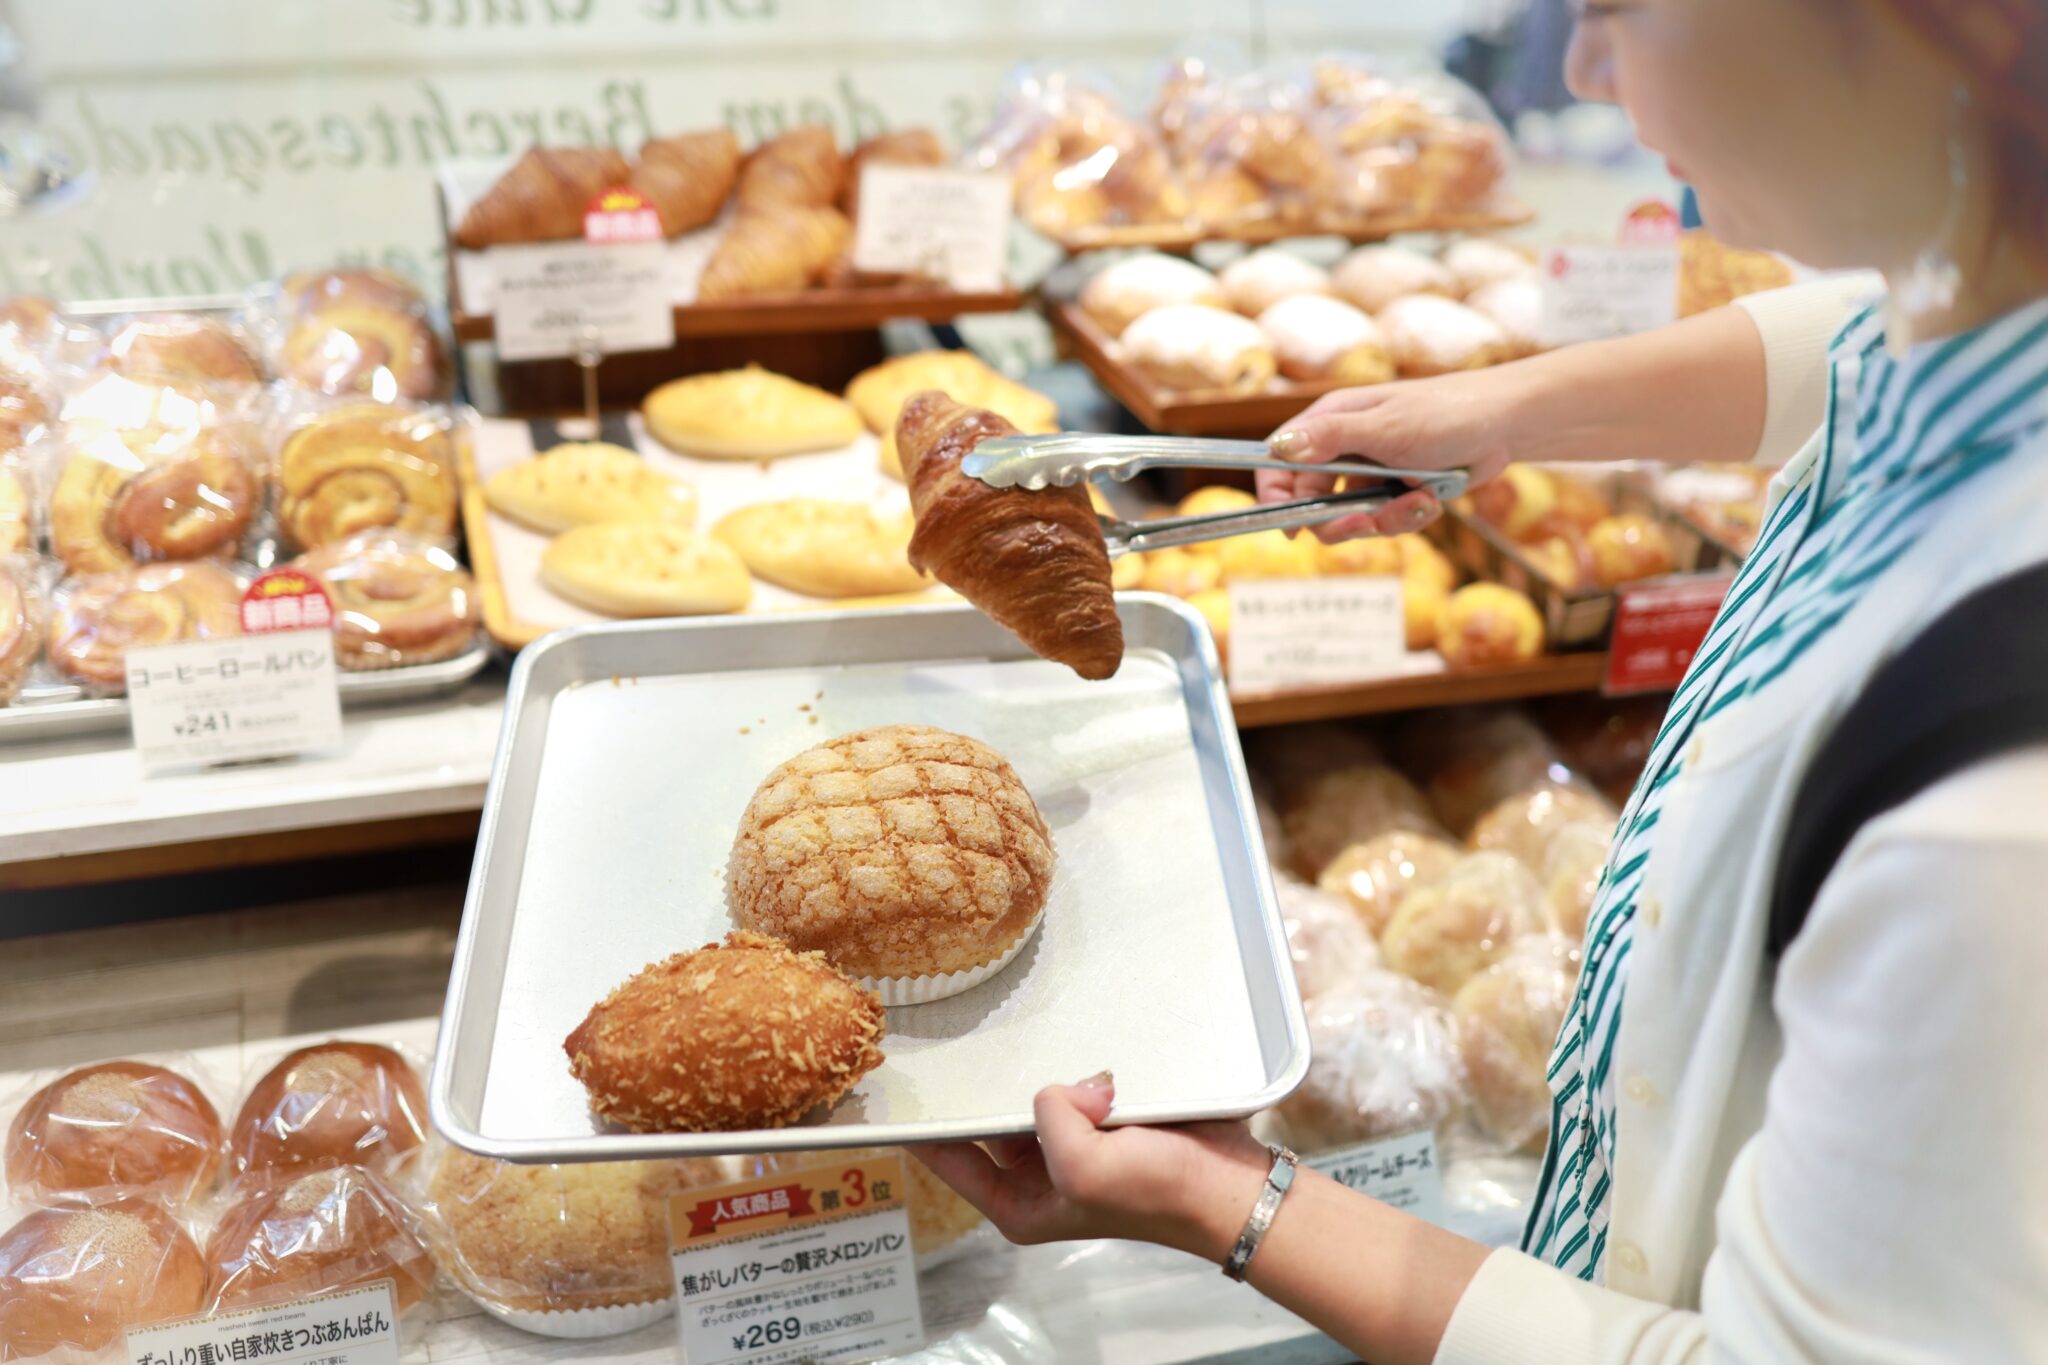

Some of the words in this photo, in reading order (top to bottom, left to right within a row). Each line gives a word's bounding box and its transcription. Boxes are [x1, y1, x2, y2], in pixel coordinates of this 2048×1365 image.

[131, 649, 326, 689] コーヒーロールパン
[711, 1189, 791, 1222] 人気商品
[820, 1168, 892, 1211] 第3位
[681, 1231, 905, 1297] 焦がしバターの贅沢メロンパン
[218, 1322, 246, 1332] mashed
[248, 1318, 268, 1327] sweet
[270, 1315, 283, 1323] red
[284, 1311, 306, 1321] beans
[732, 1316, 801, 1351] ¥269
